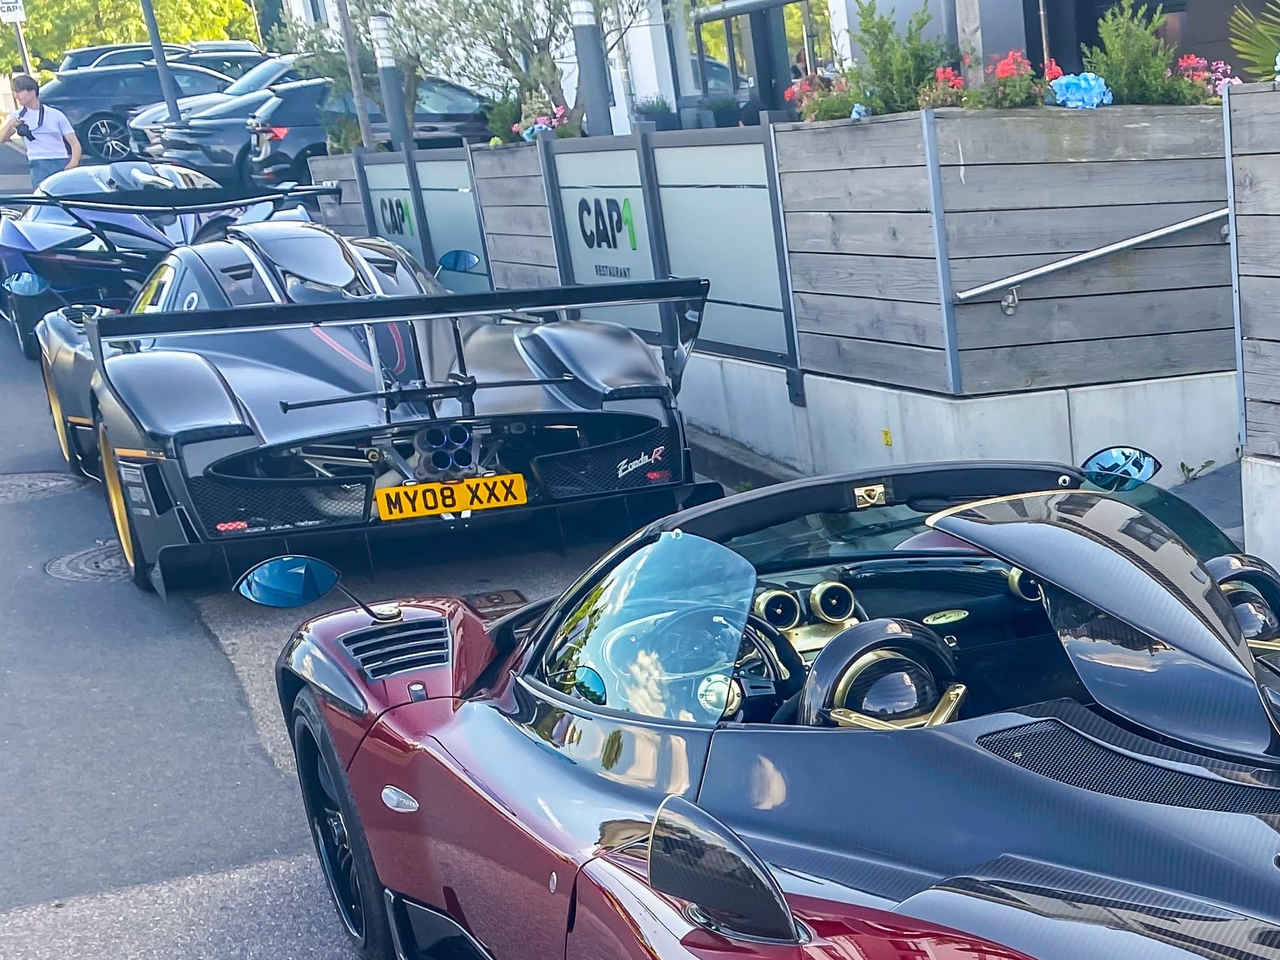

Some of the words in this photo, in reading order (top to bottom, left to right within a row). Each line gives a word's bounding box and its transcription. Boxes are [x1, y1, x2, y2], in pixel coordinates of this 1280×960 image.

[380, 197, 414, 236] CAP1
[578, 197, 637, 251] CAP1
[384, 486, 457, 515] MY08
[466, 479, 518, 506] XXX
